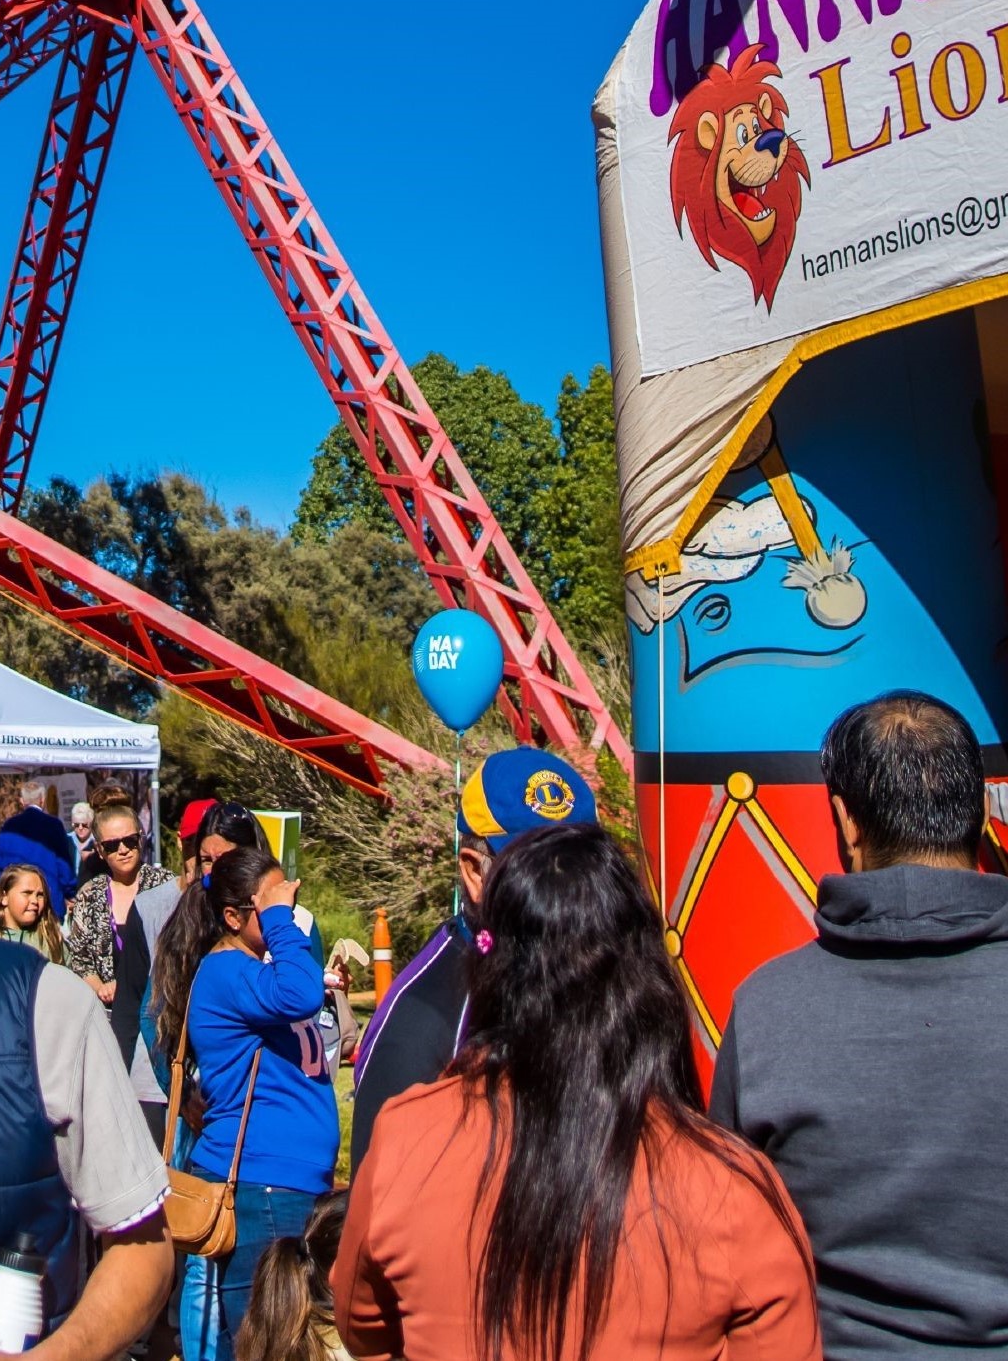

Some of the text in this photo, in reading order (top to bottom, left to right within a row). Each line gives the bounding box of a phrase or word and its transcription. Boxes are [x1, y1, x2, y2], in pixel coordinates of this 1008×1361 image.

[429, 635, 452, 651] WA
[429, 652, 459, 670] DAY
[1, 735, 70, 746] HISTORICAL
[72, 738, 119, 747] SOCIETY
[121, 739, 143, 747] INC.
[541, 785, 560, 804] L
